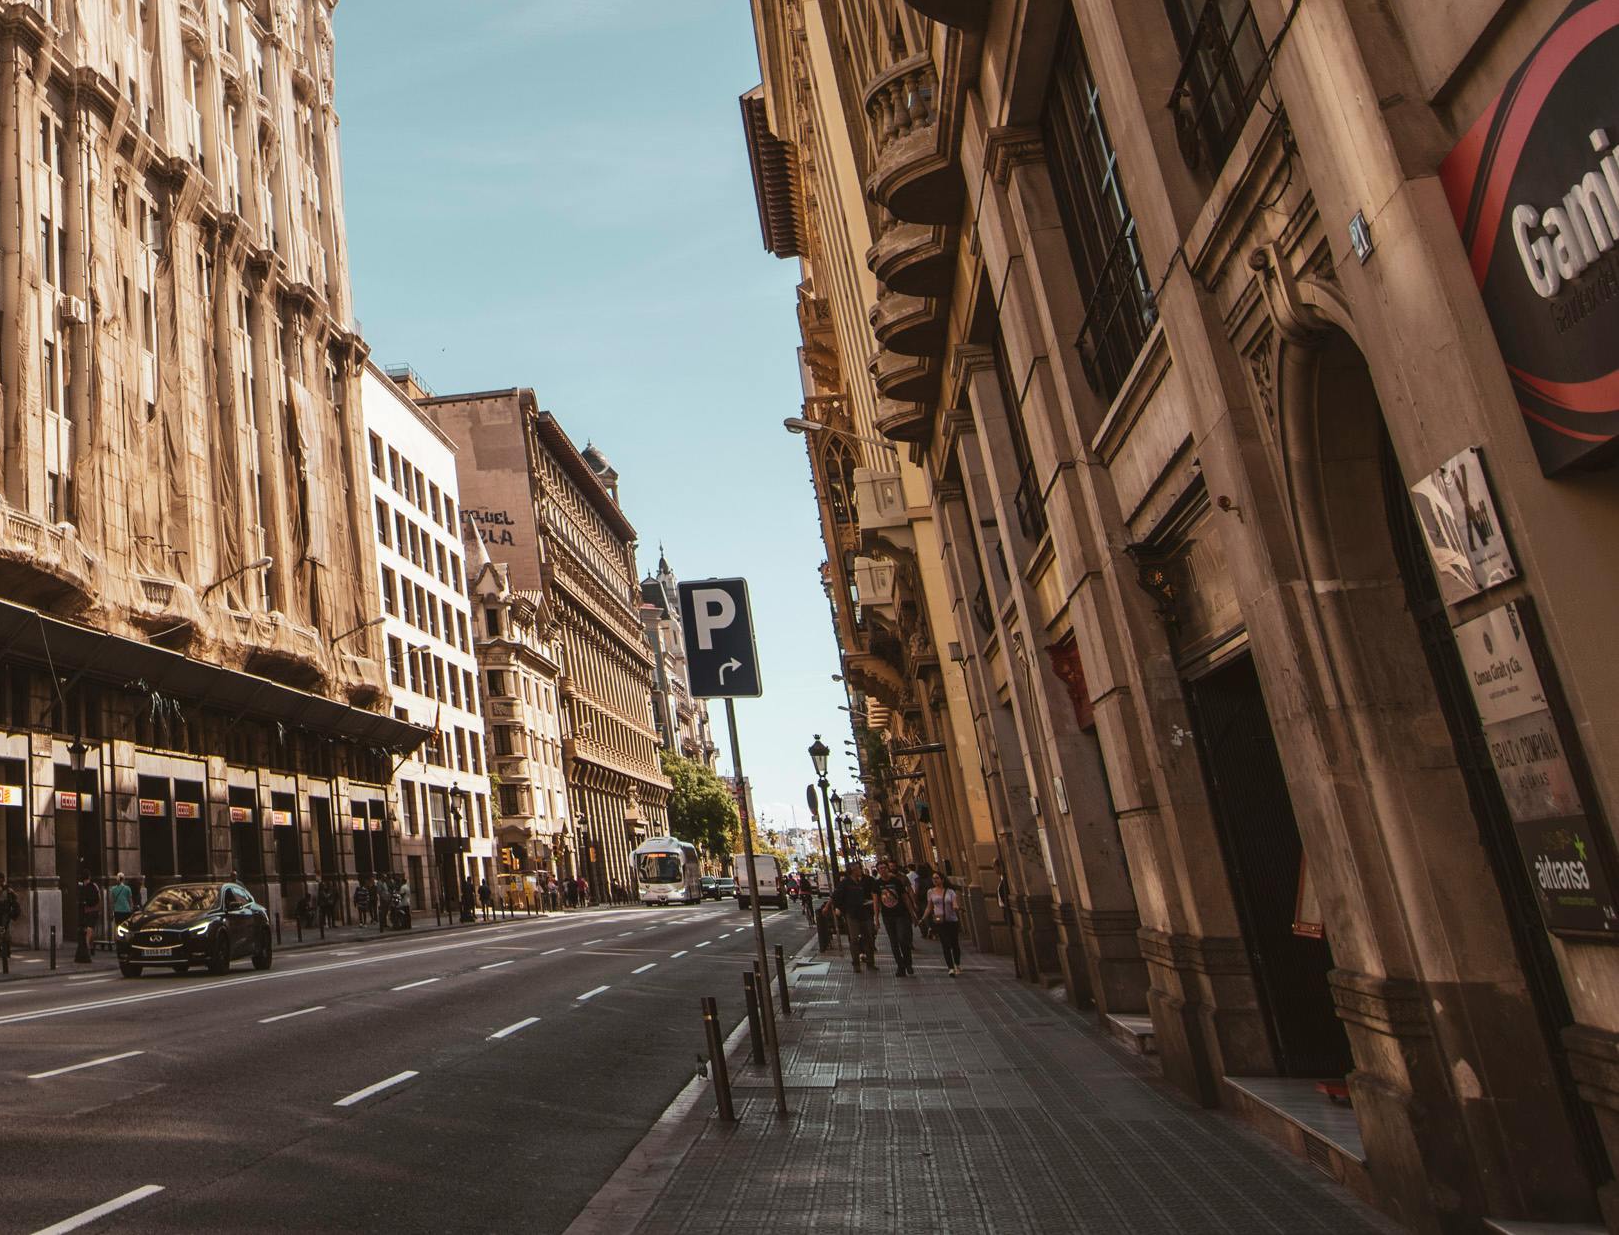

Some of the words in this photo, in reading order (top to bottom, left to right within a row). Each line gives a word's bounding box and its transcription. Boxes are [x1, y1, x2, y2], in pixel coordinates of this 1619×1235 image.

[1512, 128, 1619, 298] Gami
[692, 588, 736, 650] P
[1535, 853, 1590, 890] airtransa
